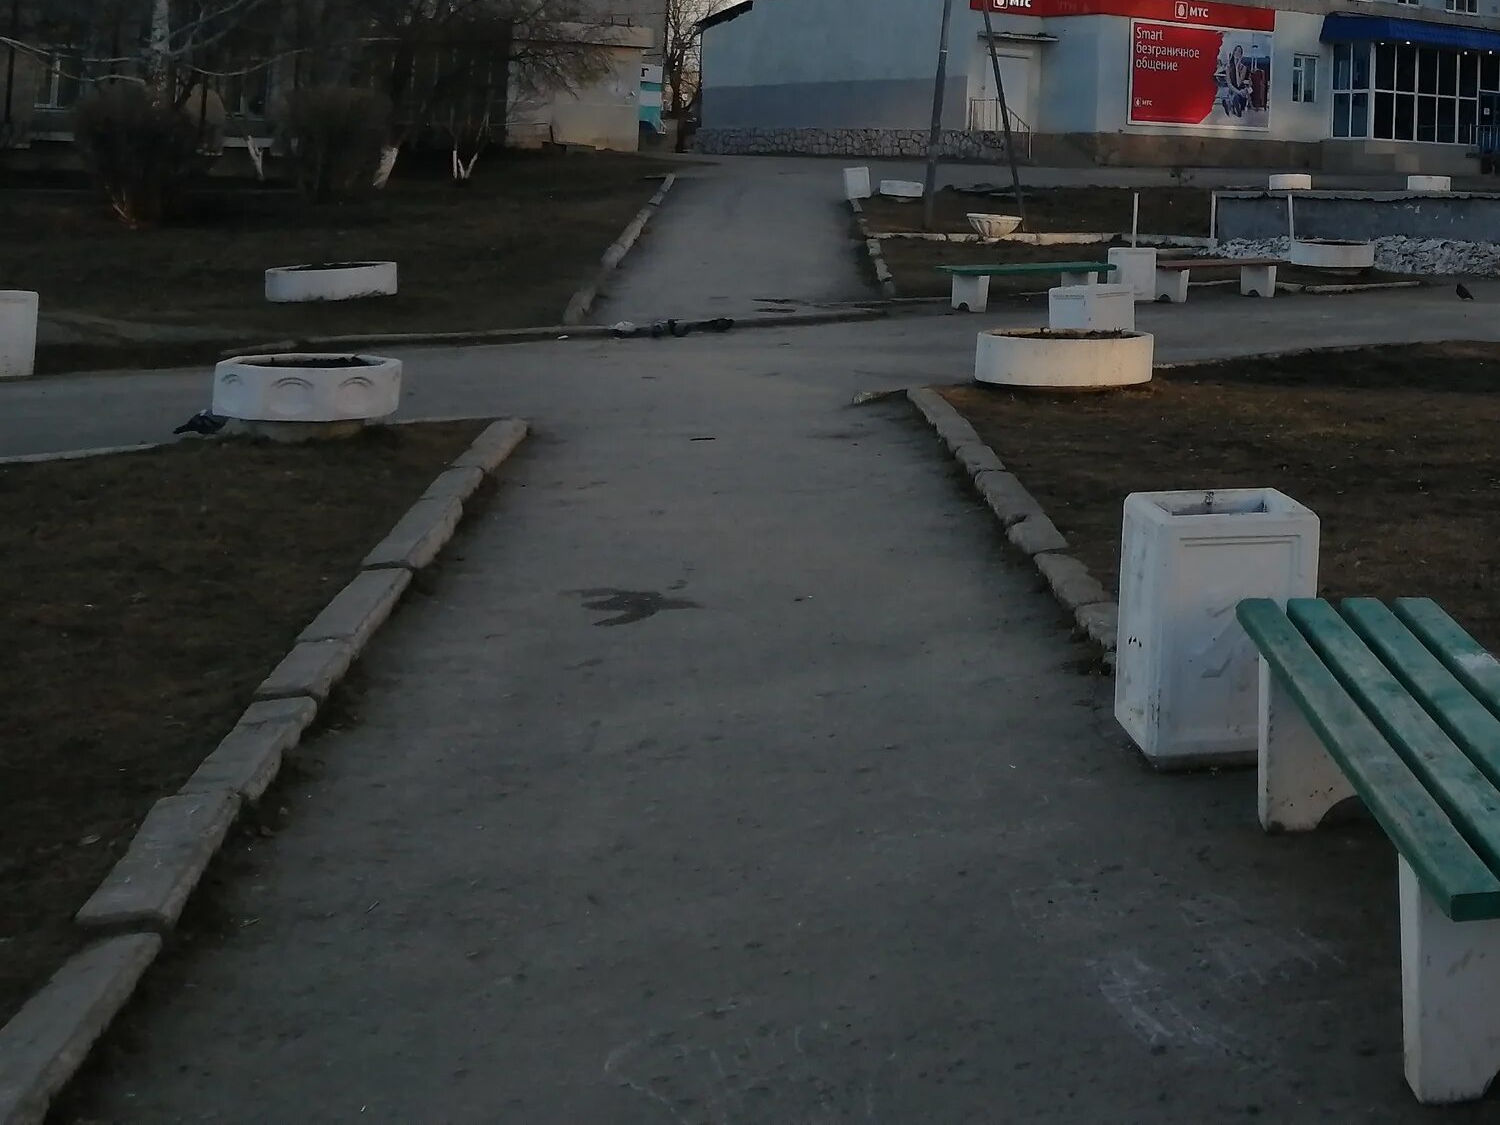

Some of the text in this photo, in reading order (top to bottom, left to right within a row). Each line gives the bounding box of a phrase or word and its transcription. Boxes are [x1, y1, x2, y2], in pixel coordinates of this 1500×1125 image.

[1189, 6, 1209, 18] МТС
[1136, 27, 1163, 41] Smart
[1136, 41, 1200, 59] безграничное
[1136, 56, 1178, 71] общение
